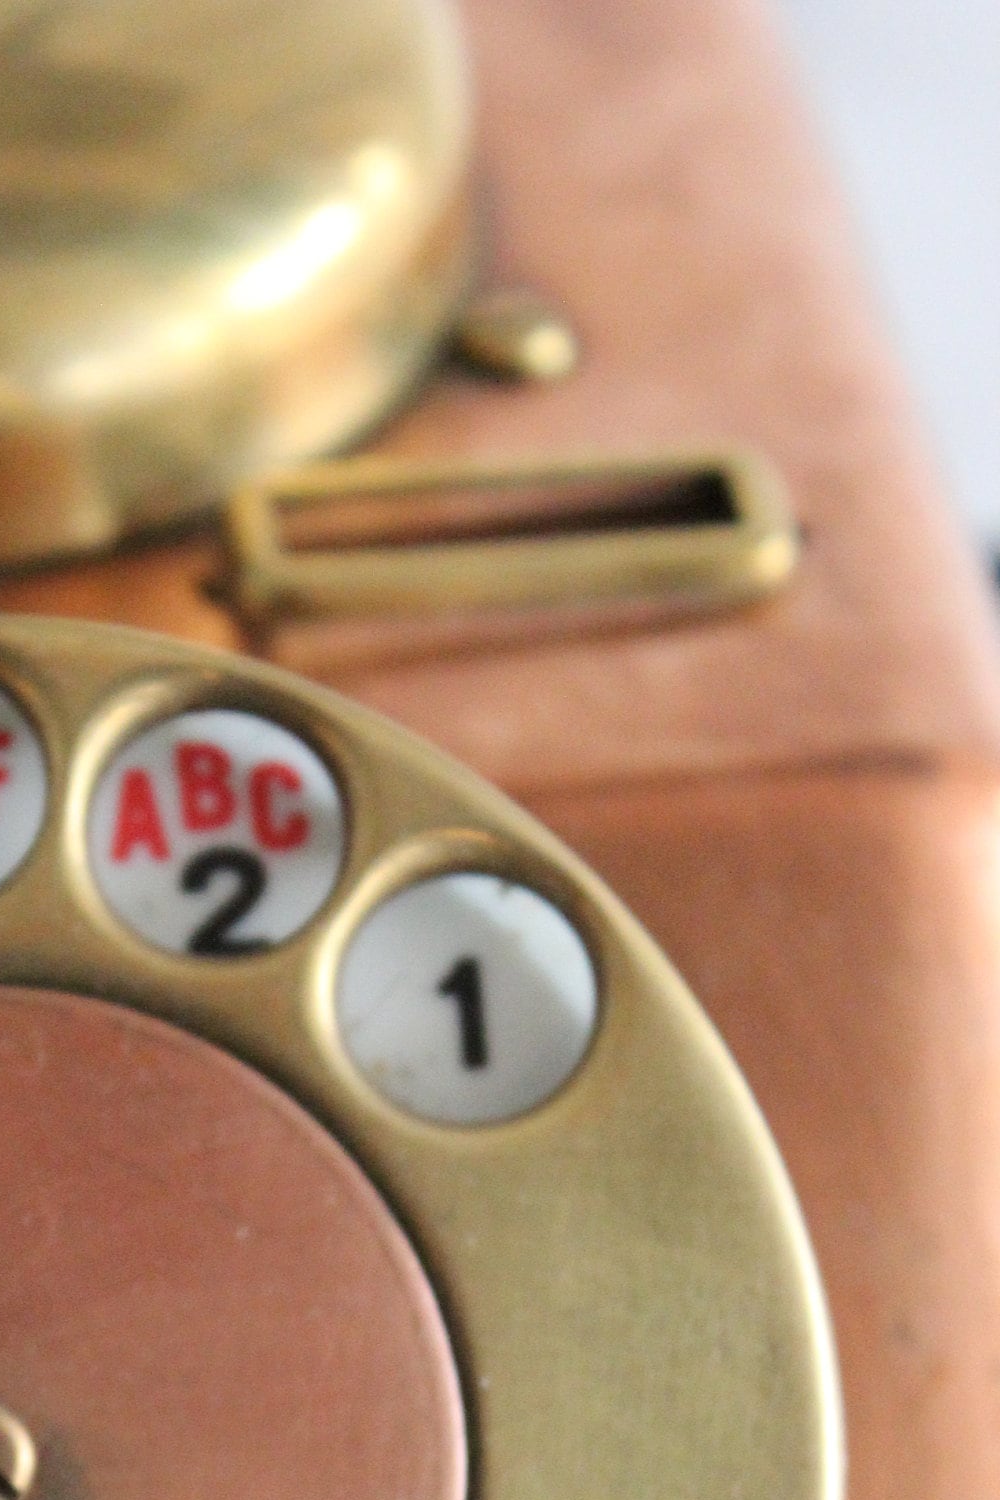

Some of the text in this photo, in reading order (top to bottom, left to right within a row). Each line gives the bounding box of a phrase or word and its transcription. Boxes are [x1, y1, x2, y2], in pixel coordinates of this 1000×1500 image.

[110, 740, 312, 862] ABC
[179, 846, 270, 960] 2
[438, 957, 489, 1072] 1
